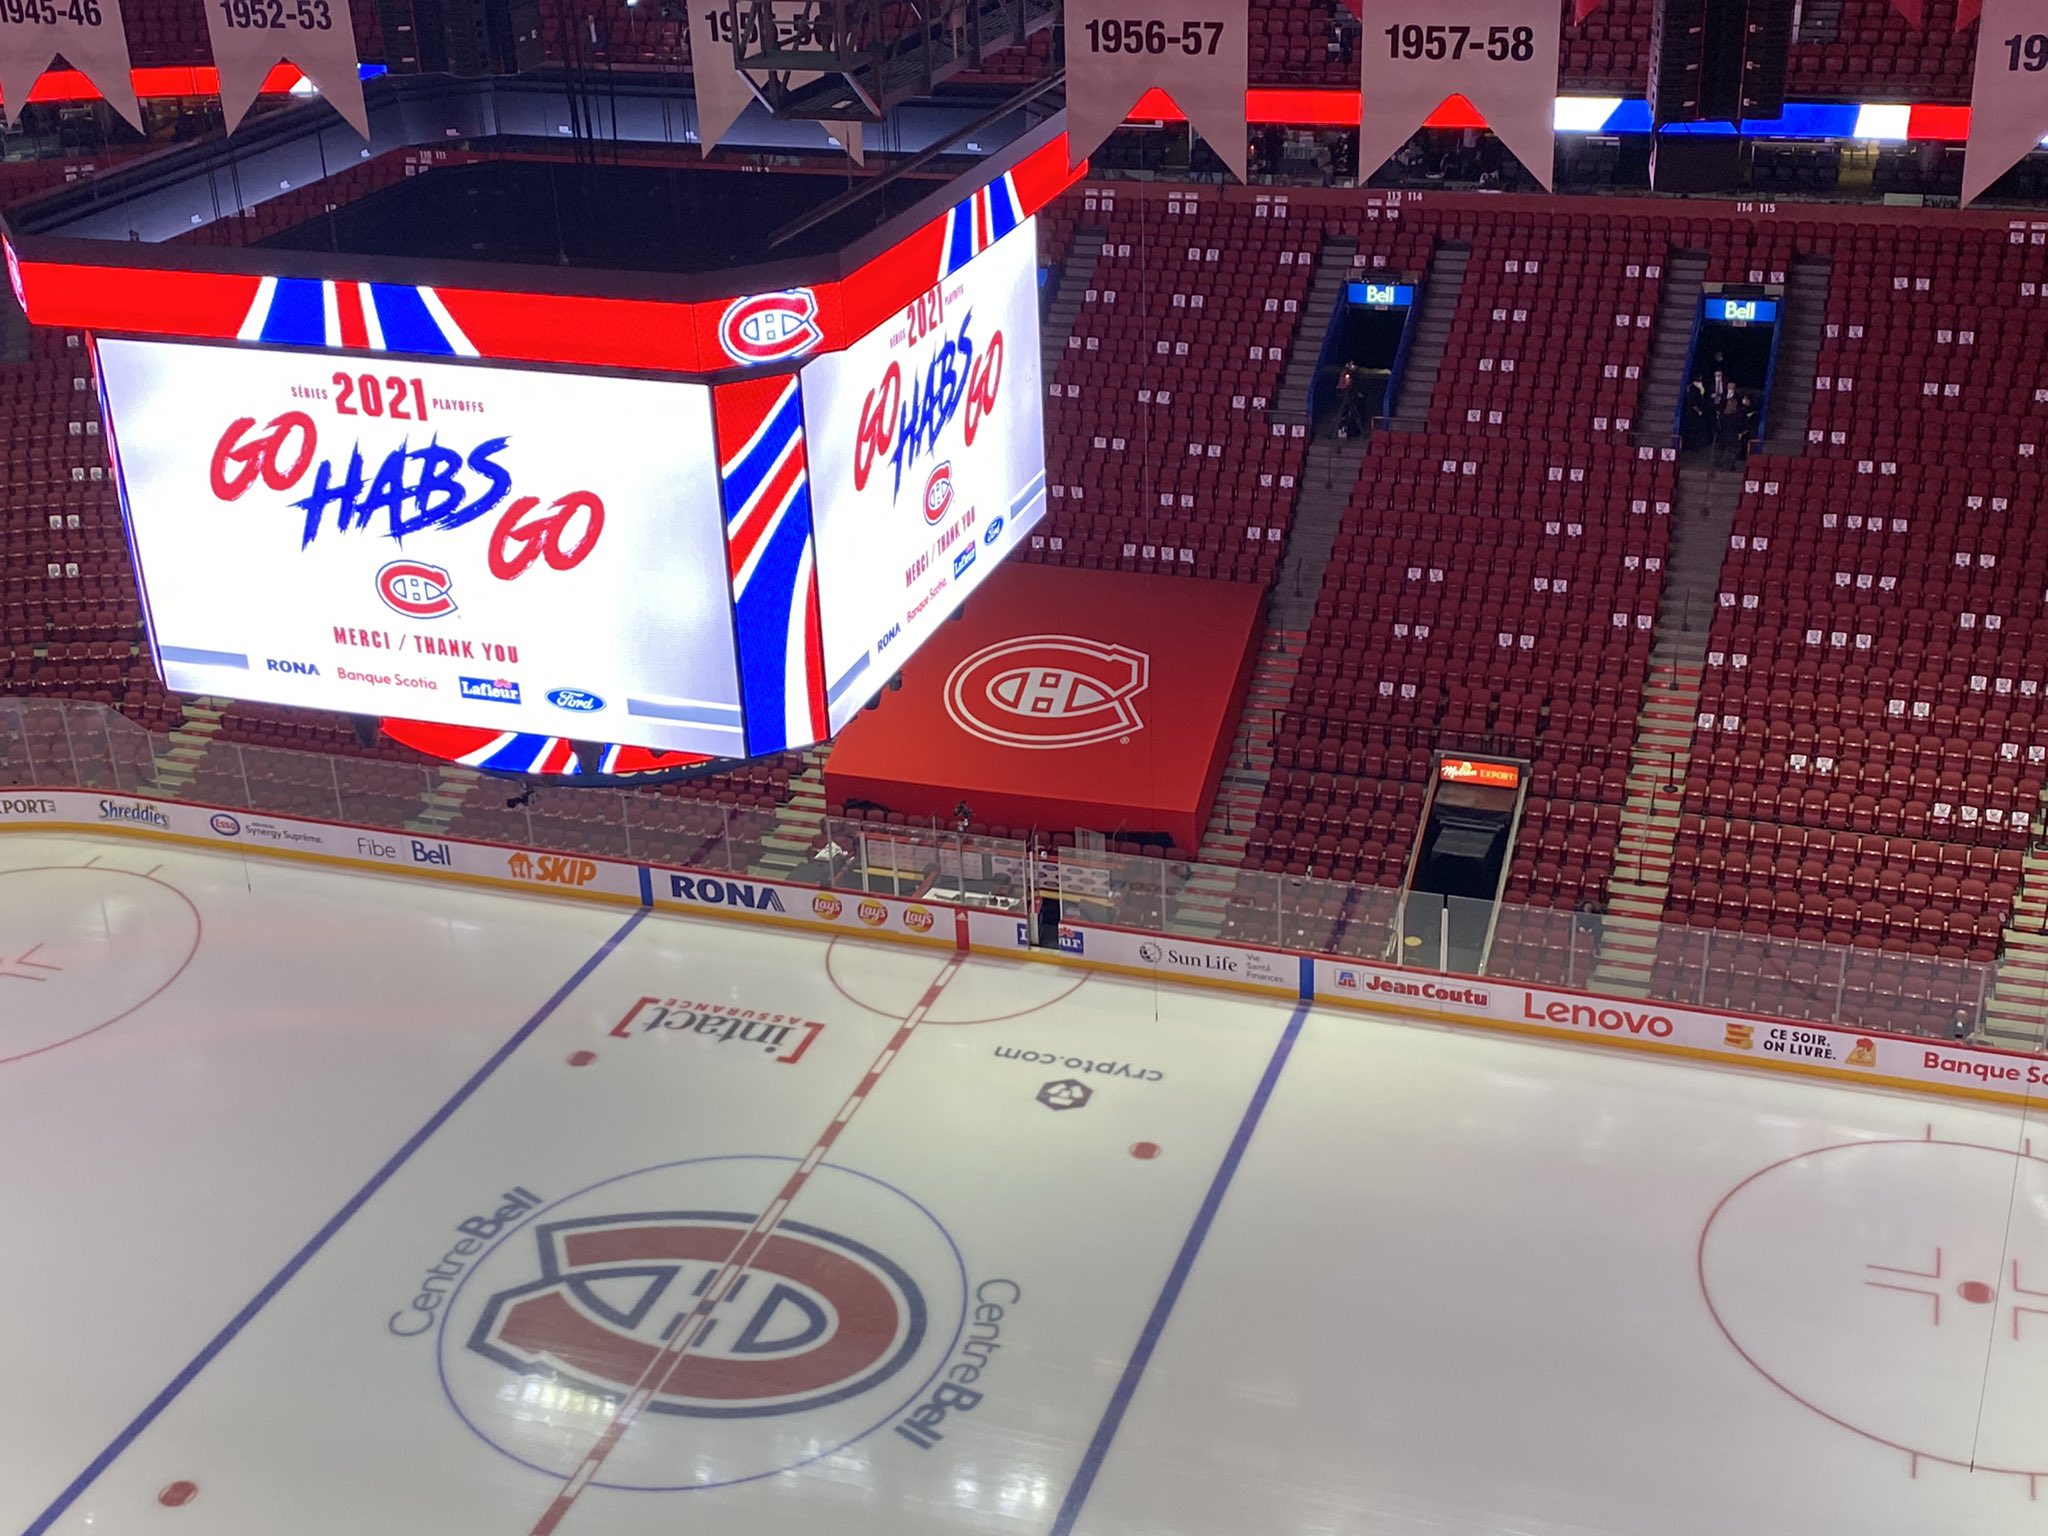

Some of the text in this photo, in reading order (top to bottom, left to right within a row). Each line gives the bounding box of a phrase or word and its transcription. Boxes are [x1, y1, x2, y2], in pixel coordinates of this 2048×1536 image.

[0, 0, 102, 26] 1945-46
[220, 0, 332, 30] 1952-53
[1085, 19, 1224, 55] 1956-57
[1385, 24, 1534, 61] 1957-58
[1737, 203, 1776, 213] 114 115
[1366, 285, 1394, 303] Bell
[906, 282, 943, 348] 2021
[1725, 300, 1756, 320] Bell
[332, 372, 428, 421] 2021
[432, 398, 484, 413] PLAYOFFS
[964, 330, 1004, 447] GO
[887, 304, 974, 508] HABS
[854, 361, 900, 491] GO
[210, 411, 317, 501] GO
[287, 430, 513, 552] HABS
[488, 490, 605, 581] GO
[905, 551, 929, 588] MERCI
[333, 626, 391, 650] MERCI
[413, 635, 474, 659] THANK
[481, 642, 519, 664] YOU
[877, 622, 901, 653] RONA
[266, 659, 320, 676] RONA
[337, 667, 438, 691] Banque Scotia
[556, 690, 594, 711] Ford
[1480, 770, 1514, 780] EXPORT
[100, 799, 169, 826] Shreddies
[245, 825, 282, 840] Synergy
[357, 837, 451, 865] Fibe Bell
[535, 856, 597, 885] SKIP
[670, 874, 786, 913] RONA
[1168, 949, 1238, 972] Sun Life
[1366, 976, 1488, 1006] Jean Coutu
[664, 997, 802, 1025] ASSURANCE
[1524, 992, 1674, 1037] Lenovo
[1763, 1040, 1837, 1061] ON LIVRE.
[1770, 1028, 1831, 1047] CE SOIR.
[994, 1045, 1164, 1082] crypto.com
[1924, 1051, 2021, 1081] Banque
